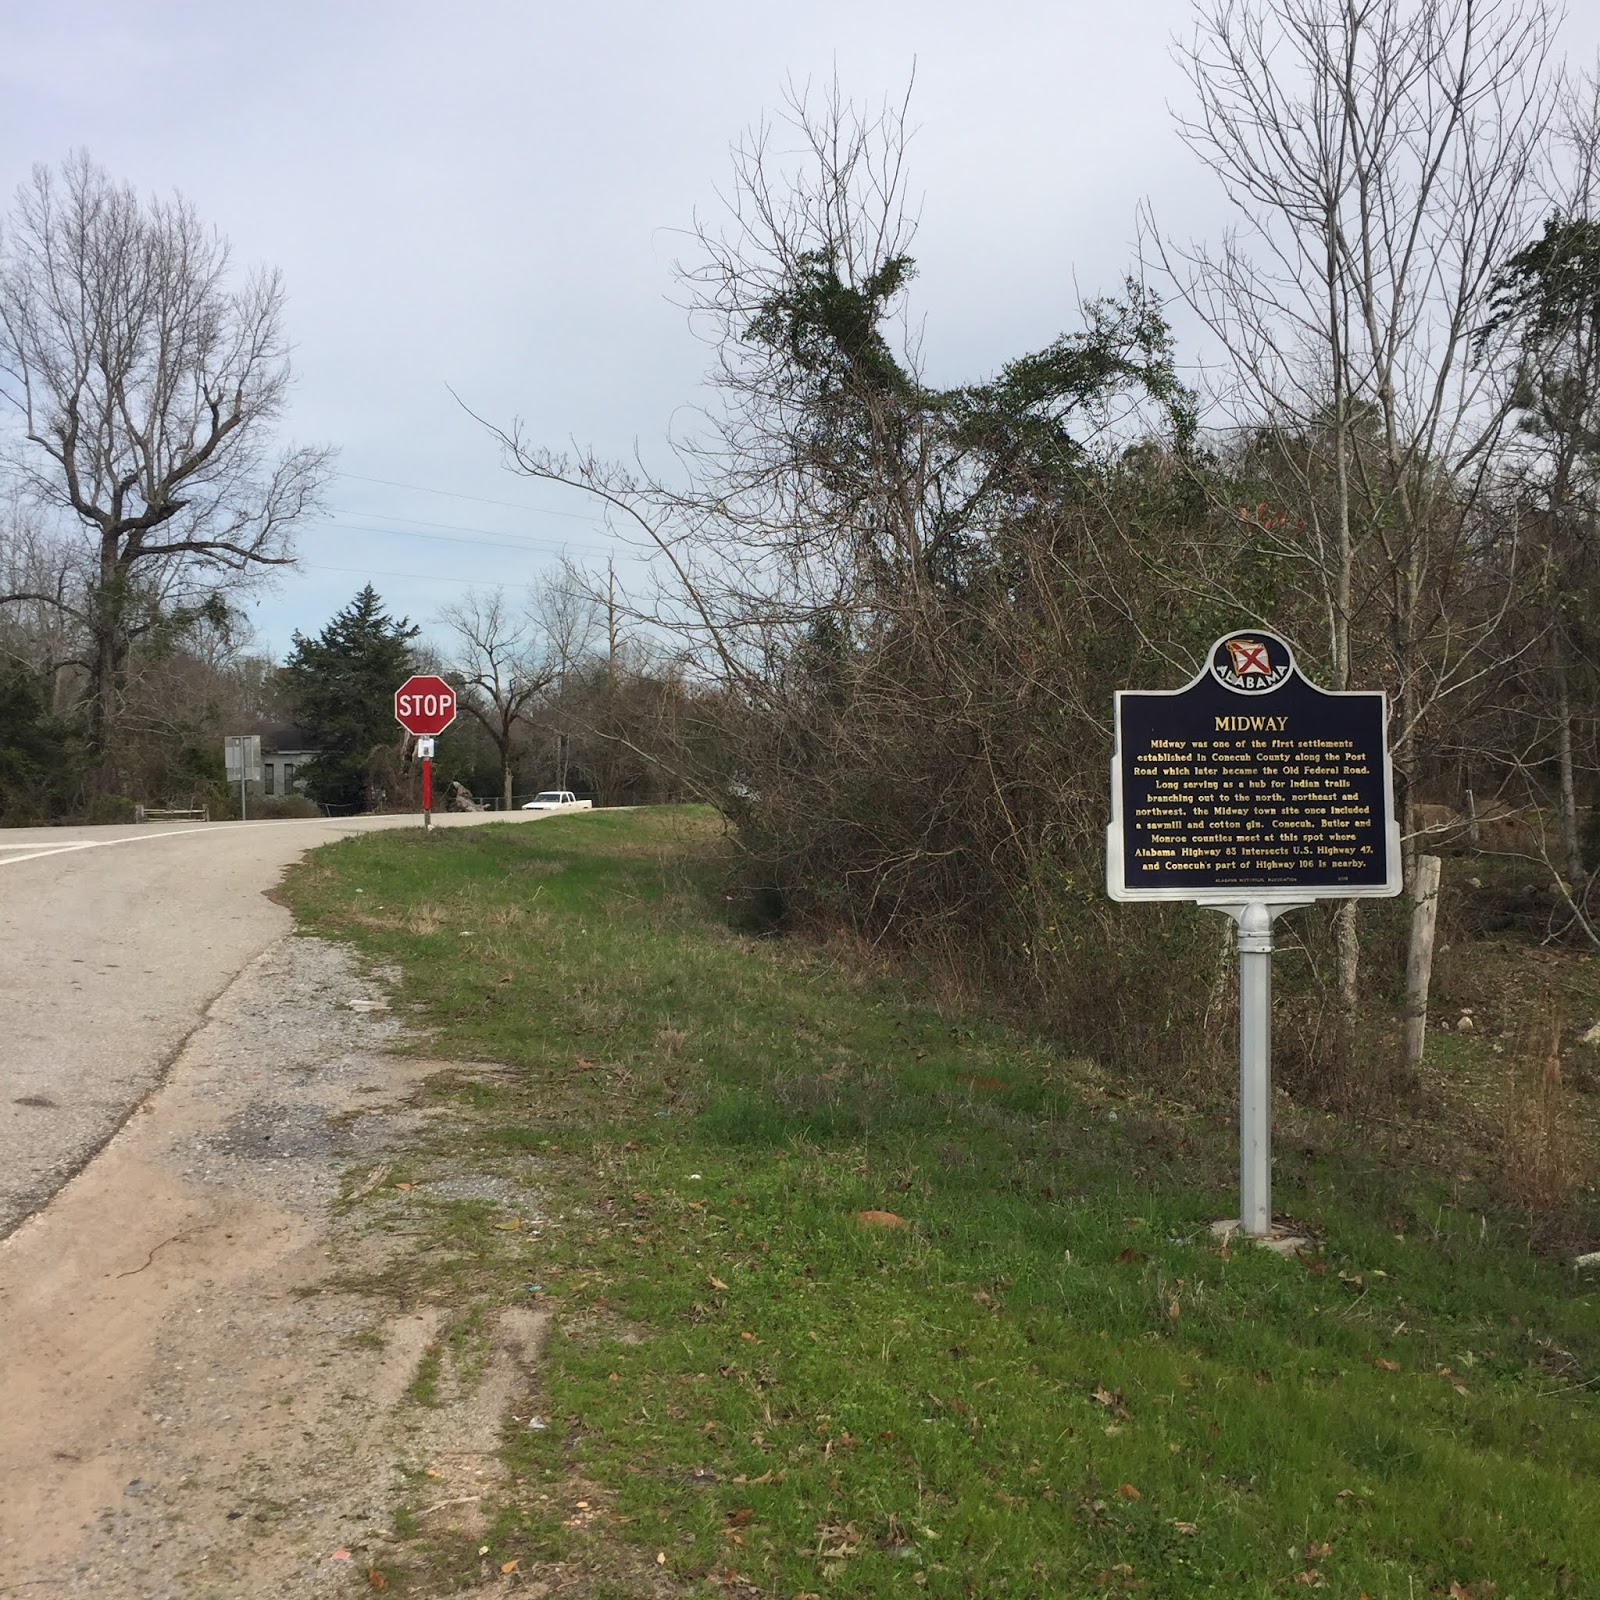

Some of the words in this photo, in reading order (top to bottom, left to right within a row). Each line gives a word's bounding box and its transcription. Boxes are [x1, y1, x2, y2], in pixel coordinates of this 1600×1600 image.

[1216, 665, 1288, 689] ALABAMA
[399, 694, 452, 717] STOP
[1214, 716, 1289, 732] MIDWAY
[1151, 739, 1187, 750] Midway
[1236, 739, 1247, 748] of
[1252, 739, 1268, 748] the
[1272, 739, 1295, 748] first
[1298, 739, 1354, 748] settlements
[1137, 752, 1193, 762] established
[1197, 753, 1207, 762] in
[1212, 752, 1252, 762] Conecuh
[1256, 752, 1291, 763] County
[1295, 752, 1321, 763] along
[1325, 752, 1341, 761] the
[1345, 752, 1367, 761] Post
[1134, 766, 1159, 776] Road
[1163, 766, 1191, 776] which
[1195, 766, 1219, 776] later
[1222, 766, 1259, 775] became
[1263, 766, 1279, 775] the
[1283, 765, 1301, 775] Old
[1304, 765, 1340, 775] Federal
[1344, 765, 1371, 775] Road.
[1156, 779, 1180, 791] Long
[1184, 780, 1219, 791] serving
[1224, 781, 1234, 789] as
[1238, 781, 1245, 789] a
[1250, 779, 1267, 789] hub
[1272, 779, 1287, 788] for
[1290, 779, 1321, 788] Indian
[1325, 779, 1351, 788] trails
[1147, 793, 1195, 804] branching
[1198, 793, 1215, 802] out
[1220, 793, 1231, 802] to
[1234, 793, 1251, 802] the
[1292, 792, 1338, 802] northeast
[1342, 792, 1360, 801] and
[1193, 806, 1209, 816] the
[1214, 806, 1250, 816] Midway
[1254, 806, 1277, 815] town
[1282, 806, 1300, 815] site
[1304, 807, 1327, 815] once
[1330, 805, 1371, 815] included
[1136, 822, 1143, 830] a
[1147, 820, 1183, 830] sawmill
[1187, 819, 1205, 829] and
[1209, 820, 1241, 829] cotton
[1246, 819, 1265, 831] gin.
[1321, 818, 1351, 828] Butler
[1354, 818, 1372, 828] and
[1152, 834, 1188, 843] Monroe
[1192, 833, 1233, 843] counties
[1236, 833, 1261, 842] meet
[1264, 833, 1275, 842] at
[1280, 832, 1299, 842] this
[1303, 833, 1325, 843] spot
[1329, 832, 1357, 841] where
[1135, 847, 1177, 857] Alabama
[1182, 847, 1223, 858] Highway
[1242, 846, 1289, 856] intersects
[1293, 845, 1314, 855] U.S.
[1317, 845, 1357, 856] Highway
[1142, 861, 1161, 871] and
[1165, 860, 1213, 871] Conecuh's
[1215, 860, 1237, 871] part
[1240, 860, 1253, 869] of
[1256, 860, 1297, 871] Highway
[1300, 859, 1315, 868] 106
[1318, 859, 1327, 868] is
[1332, 859, 1367, 869] nearby.
